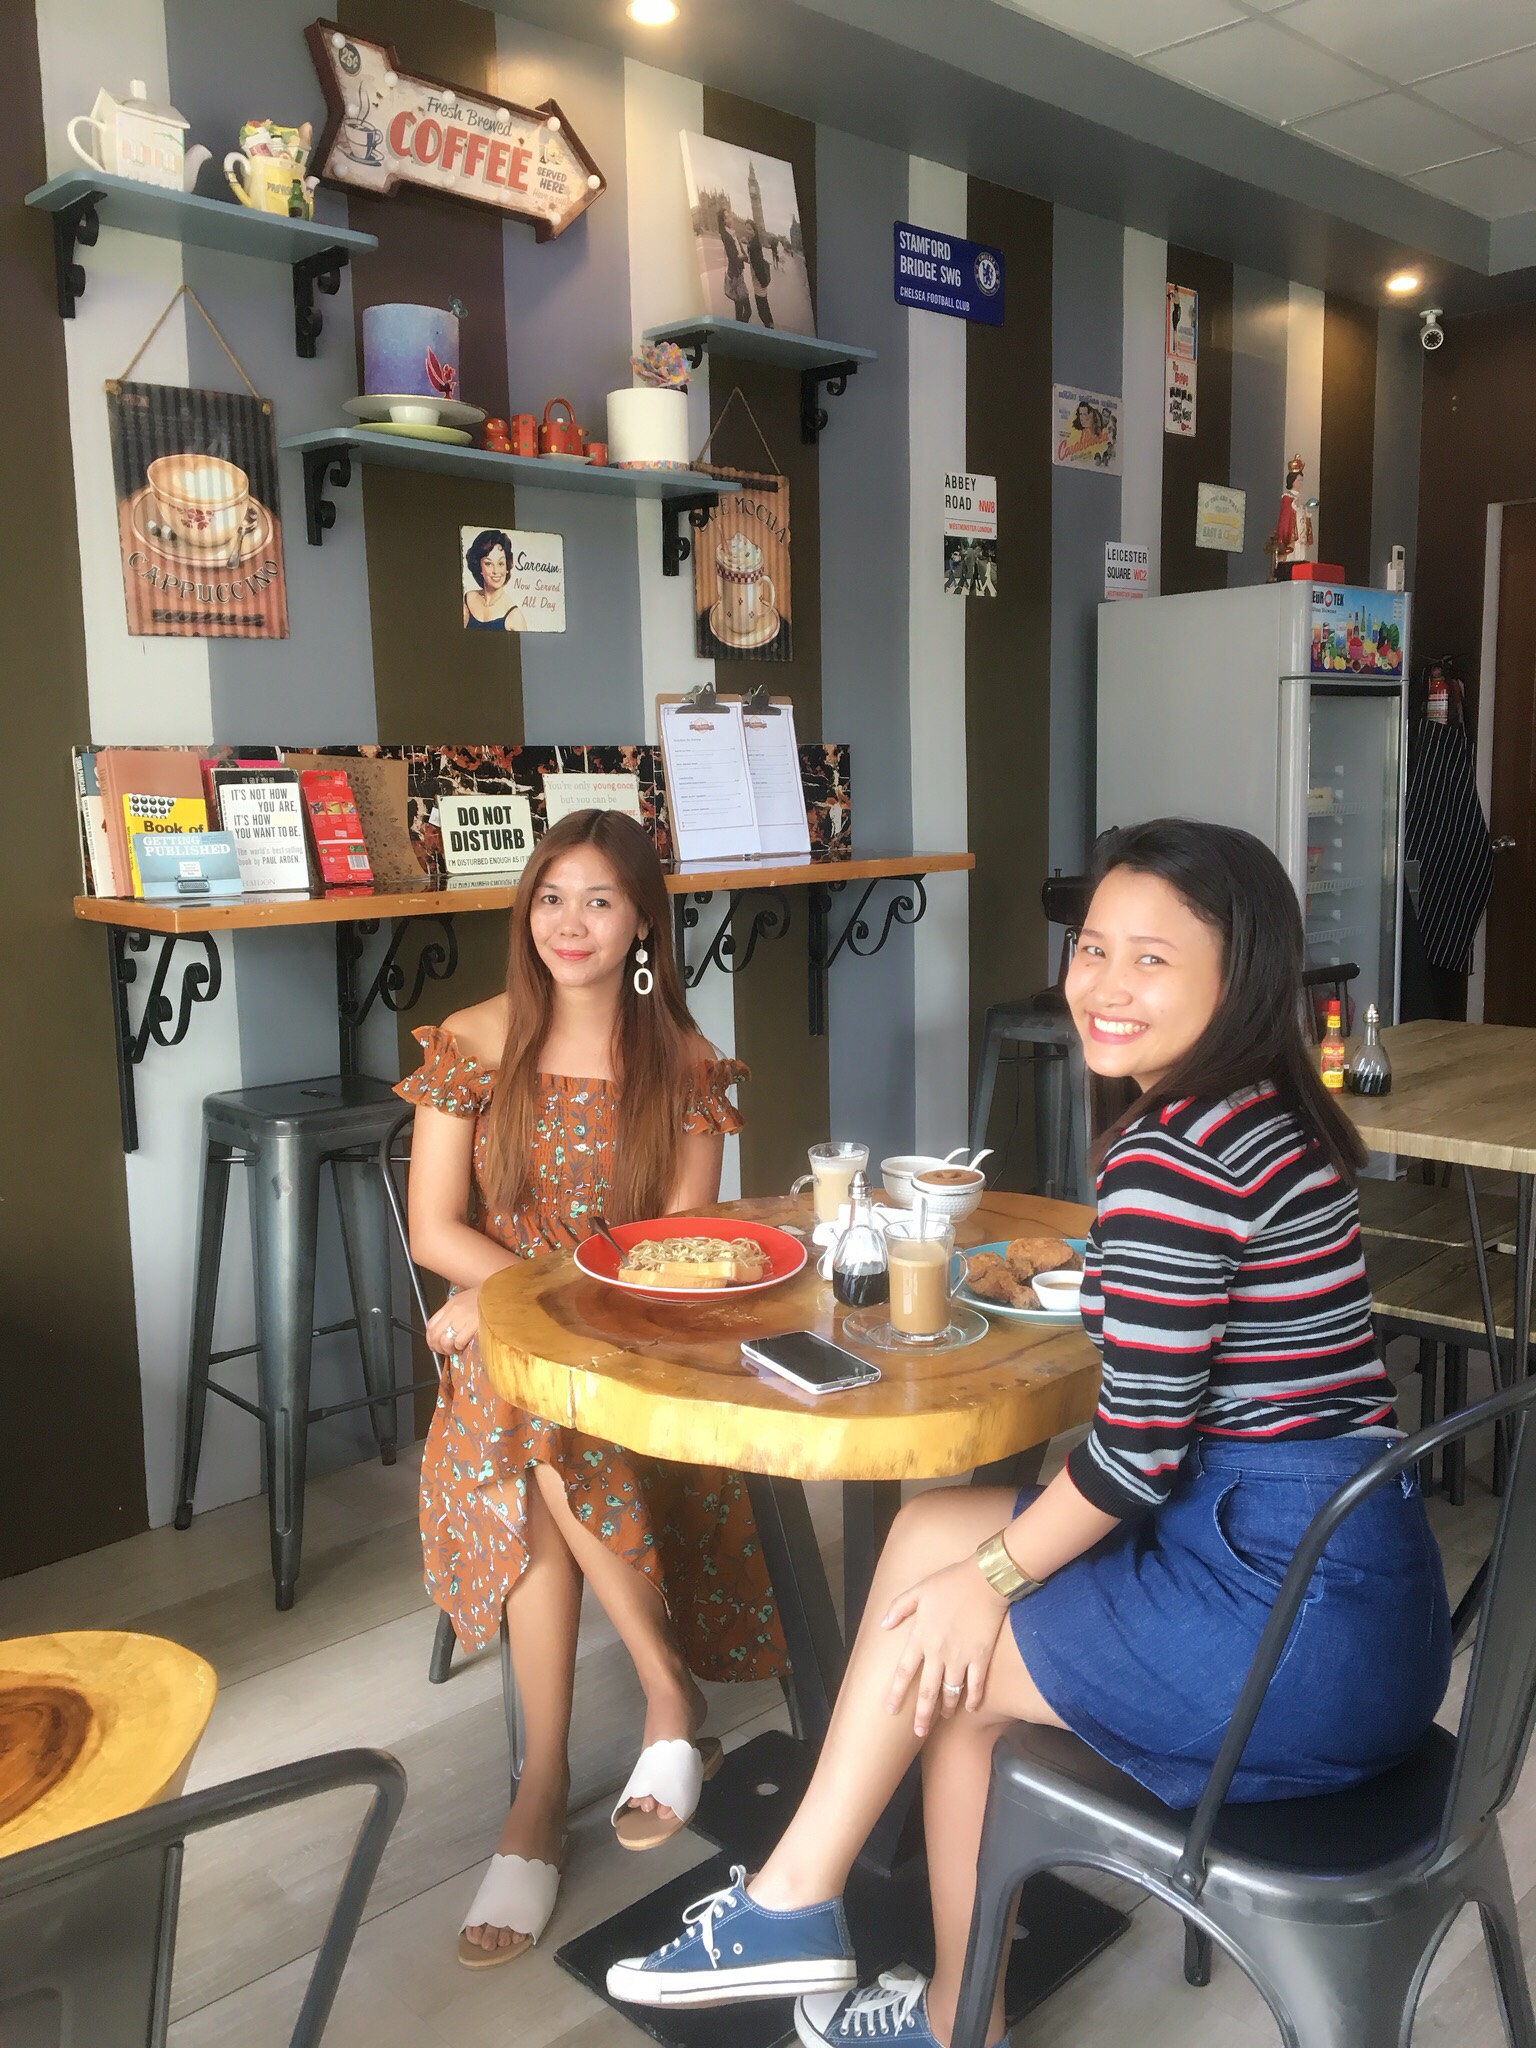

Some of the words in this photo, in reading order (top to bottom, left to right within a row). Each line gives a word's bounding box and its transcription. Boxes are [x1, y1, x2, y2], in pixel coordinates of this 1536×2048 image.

[427, 96, 463, 122] Fresh
[467, 108, 512, 136] Brewed
[388, 111, 533, 193] COFFEE
[537, 166, 567, 182] SERVED
[540, 178, 565, 194] HERE
[900, 231, 951, 261] STAMFORD
[900, 255, 937, 281] BRIDGE
[941, 265, 962, 287] SW6
[900, 286, 925, 301] CHELSEA
[927, 292, 955, 308] FOOTBALL
[956, 299, 970, 311] CLUB
[945, 475, 976, 491] ABBEY
[946, 495, 972, 510] ROAD
[979, 500, 995, 513] NW8
[735, 497, 786, 543] MOCHA
[1107, 549, 1147, 564] LEICESTER
[128, 552, 280, 604] CAPPUCCINO
[1107, 566, 1131, 580] SQUARE
[1133, 569, 1147, 581] WC2
[514, 578, 530, 589] Now
[535, 579, 560, 592] Served
[522, 596, 536, 608] All
[541, 597, 556, 612] Day
[547, 781, 572, 790] You're
[574, 782, 591, 791] only
[592, 783, 616, 791] young
[231, 789, 246, 801] IT'S
[250, 789, 265, 801] NOT
[270, 788, 287, 800] HOW
[608, 795, 617, 803] be
[258, 801, 274, 813] YOU
[279, 801, 298, 813] ARE,
[234, 814, 249, 826] IT'S
[252, 814, 271, 825] HOW
[457, 806, 479, 826] DO
[483, 806, 511, 825] NOT
[143, 820, 183, 833] Book
[189, 824, 204, 833] of
[235, 828, 251, 839] YOU
[253, 827, 275, 837] WANT
[278, 826, 287, 837] TO
[289, 826, 301, 837] BE.
[143, 836, 200, 846] GETTING
[450, 829, 525, 852] DISTURB
[144, 844, 231, 857] PUBLISHED
[262, 856, 277, 864] PAUL
[280, 855, 301, 864] ARDEN.
[457, 858, 488, 867] DISTURBED
[490, 857, 511, 865] ENOUGH
